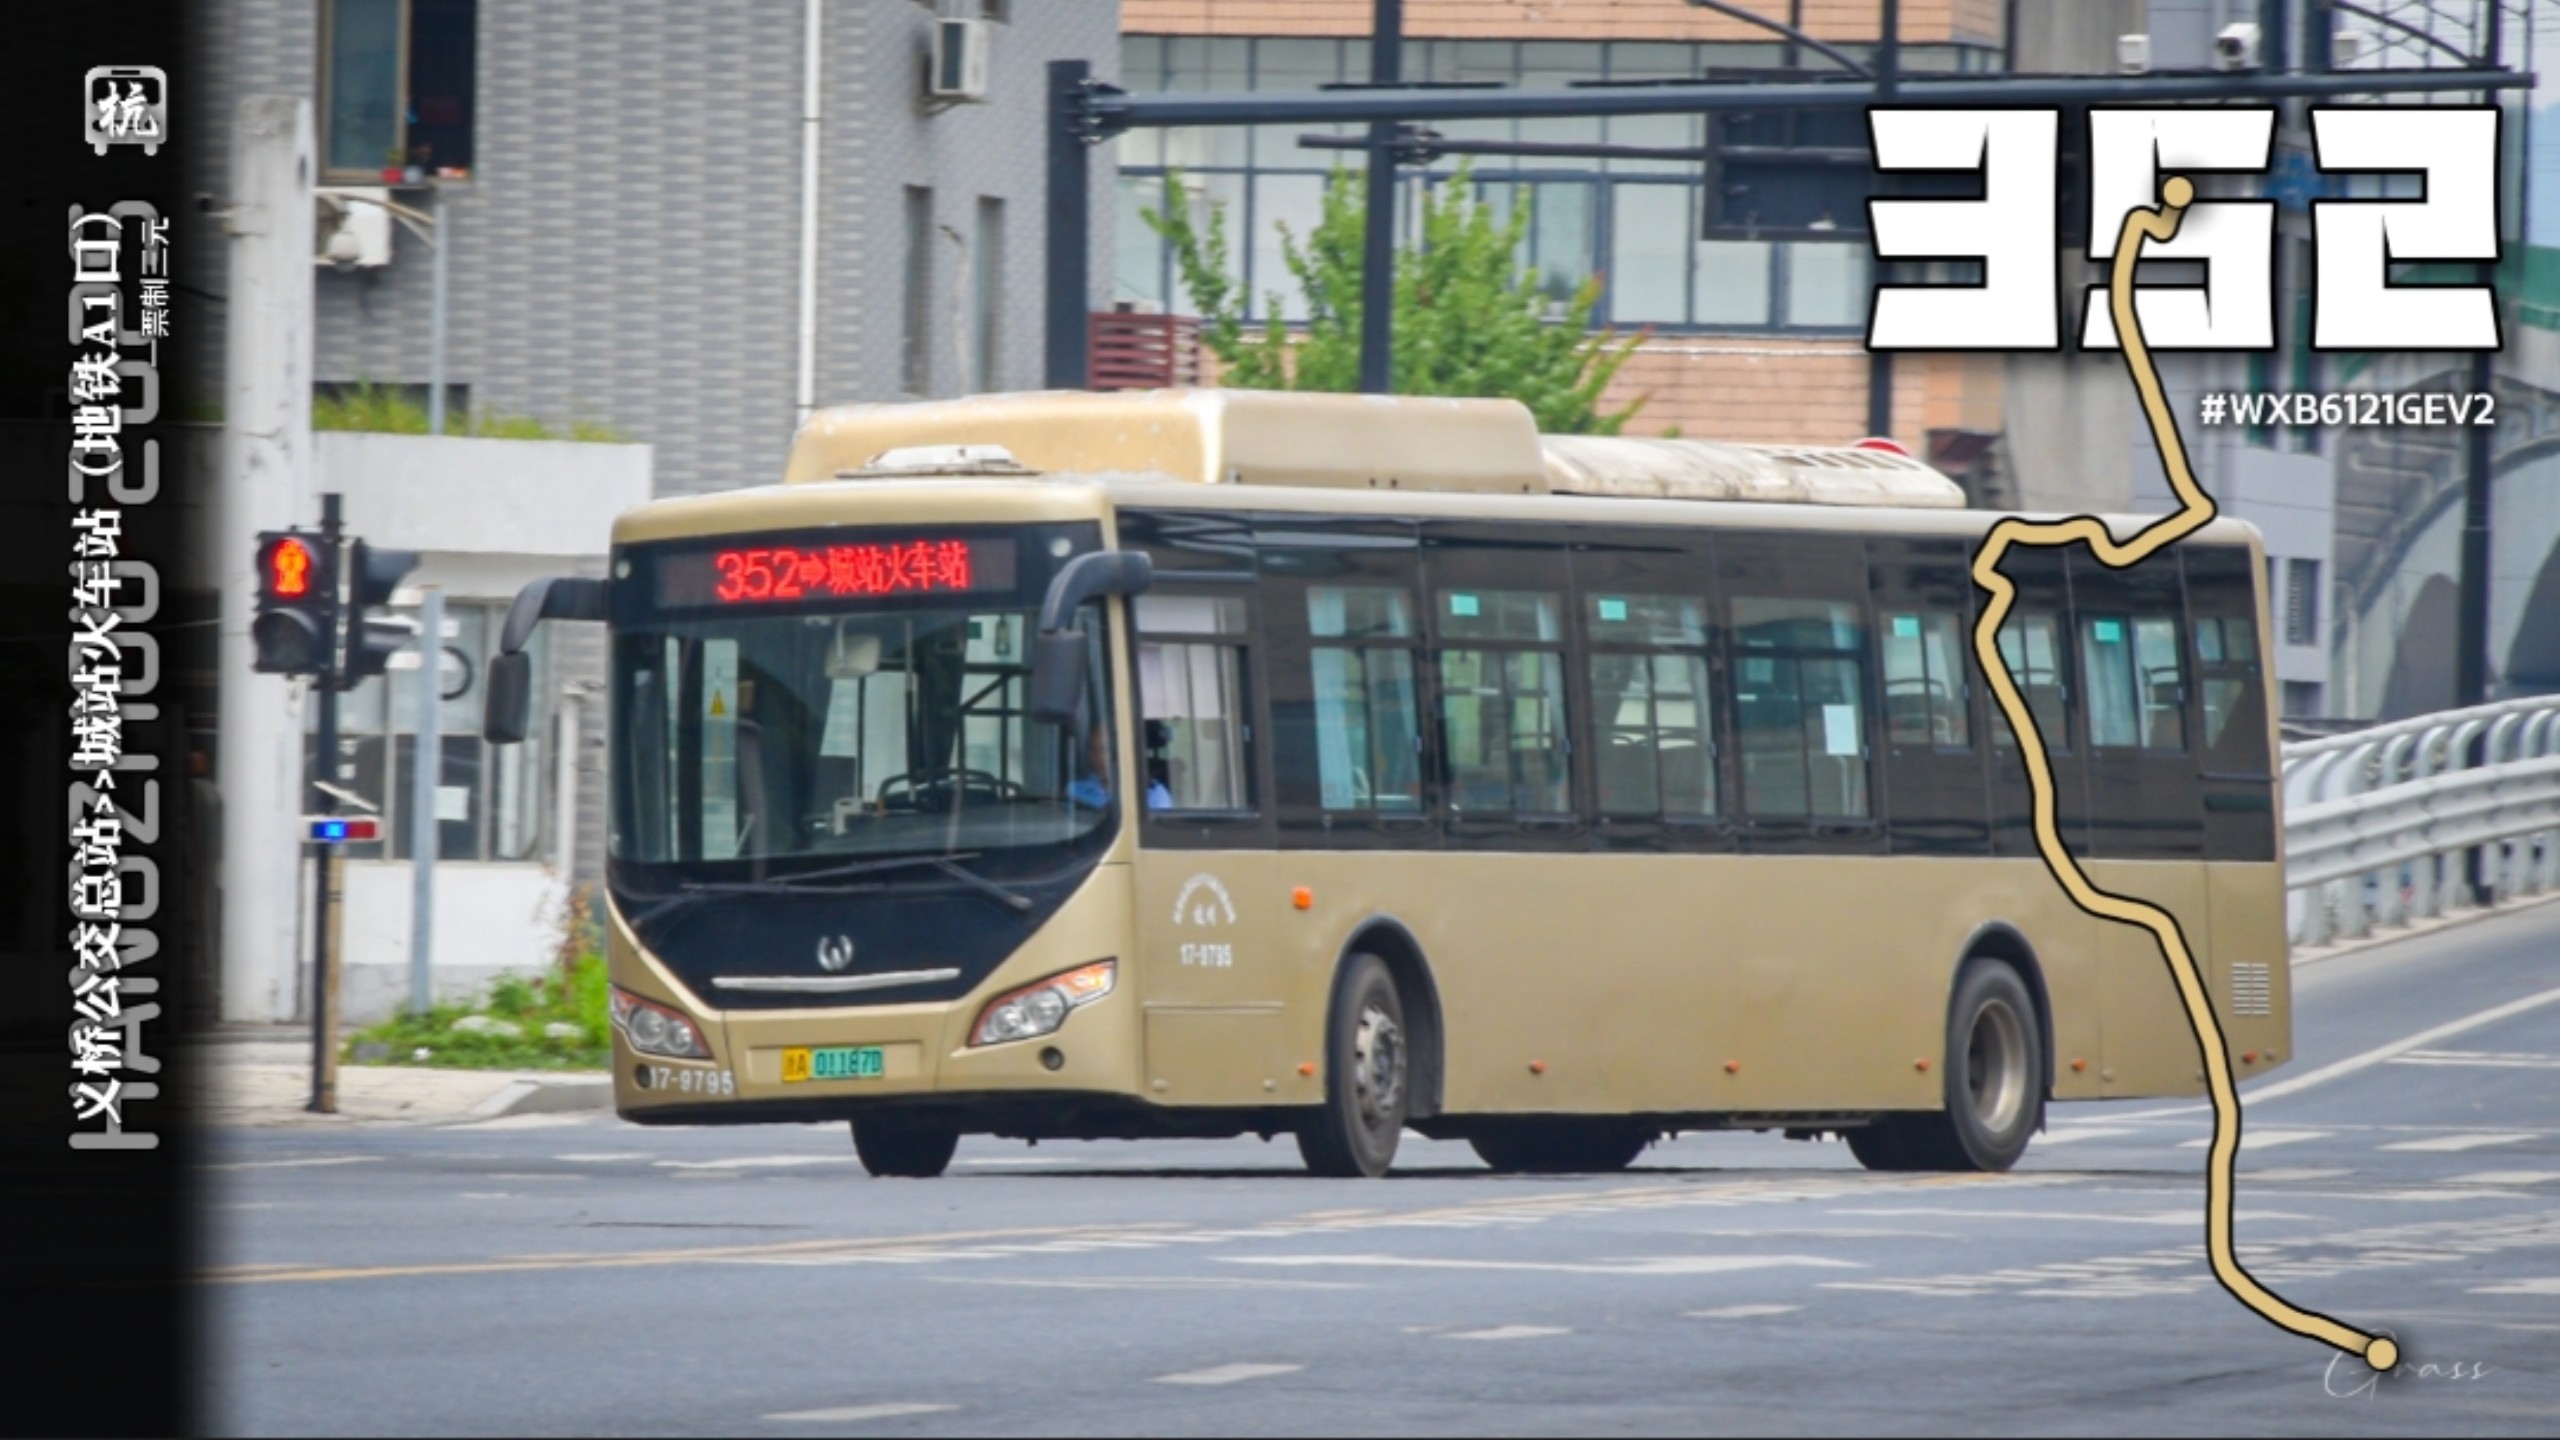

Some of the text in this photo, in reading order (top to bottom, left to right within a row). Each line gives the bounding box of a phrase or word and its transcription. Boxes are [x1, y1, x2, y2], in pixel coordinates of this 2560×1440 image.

[715, 540, 970, 602] 352 城站火车站
[650, 1066, 734, 1094] 17-9795
